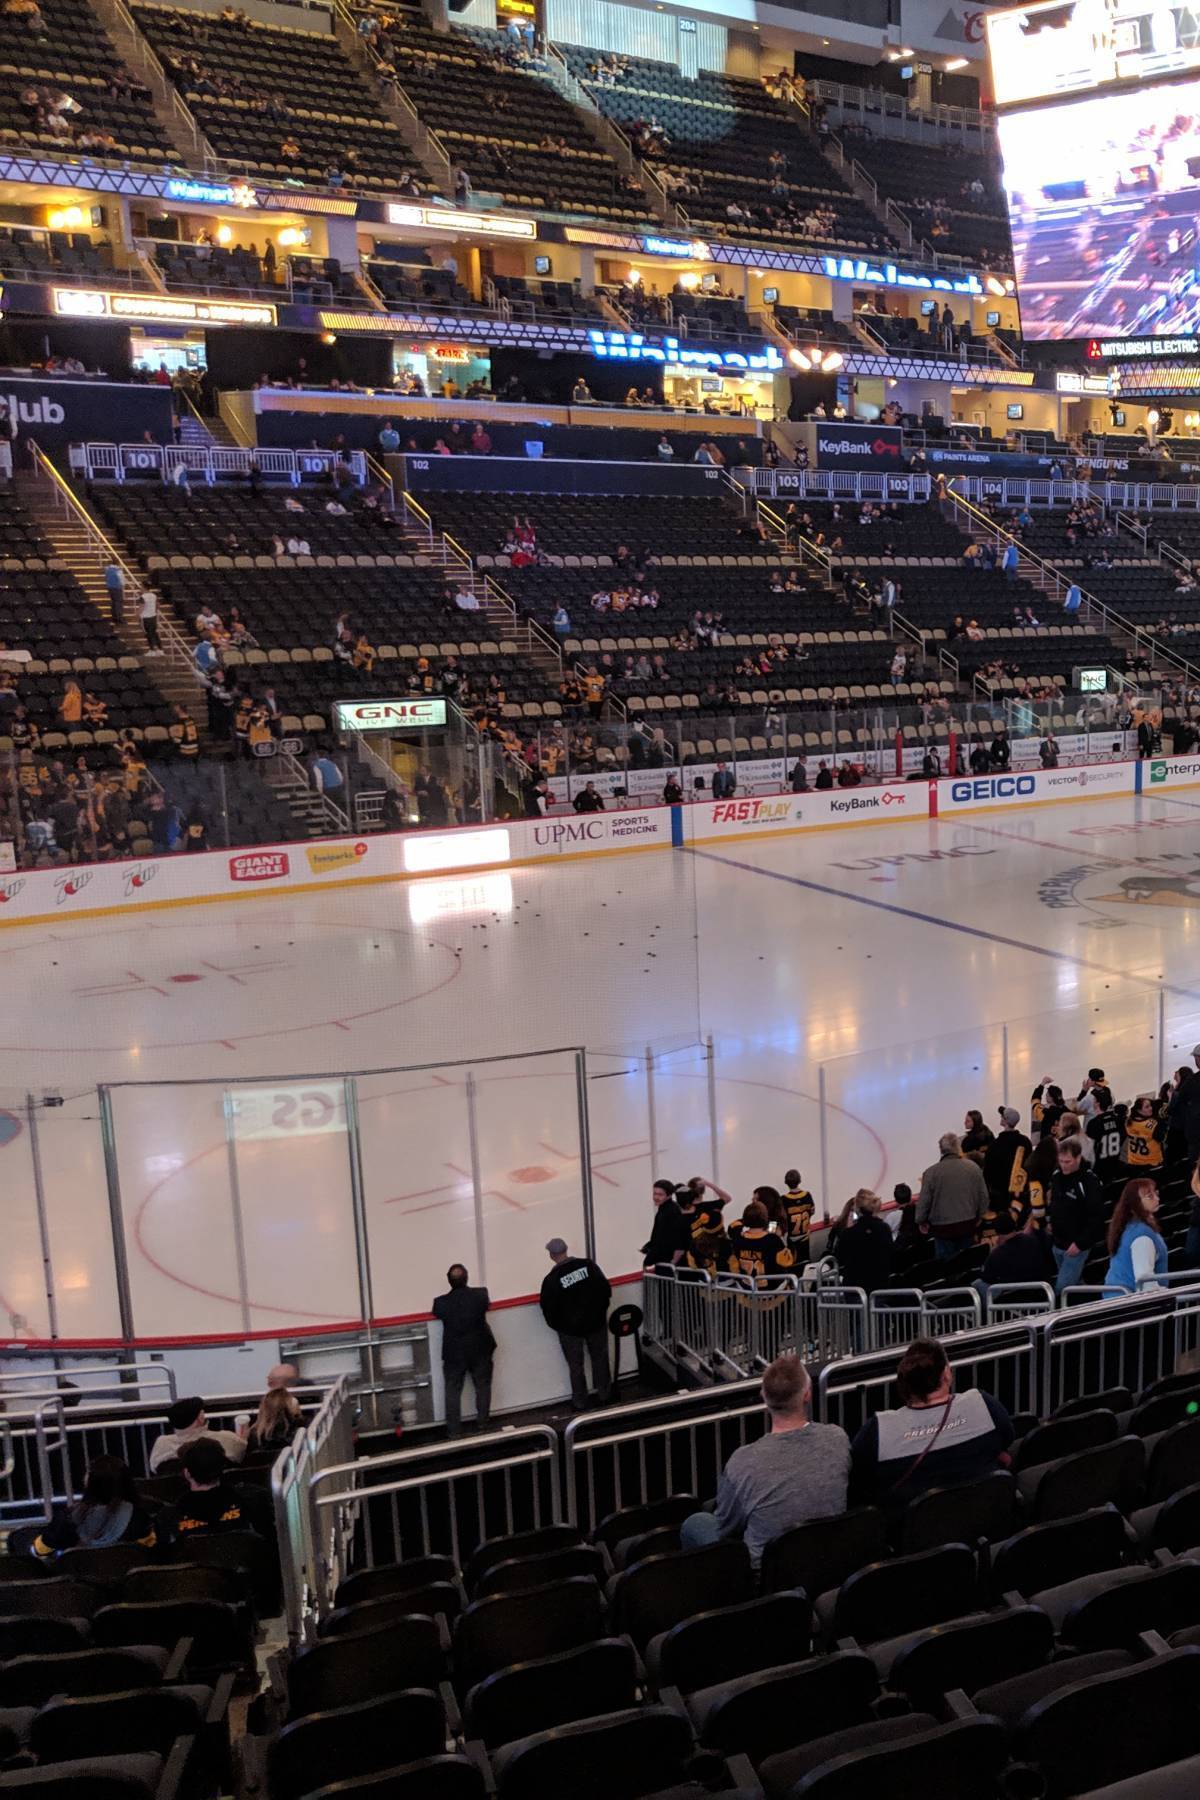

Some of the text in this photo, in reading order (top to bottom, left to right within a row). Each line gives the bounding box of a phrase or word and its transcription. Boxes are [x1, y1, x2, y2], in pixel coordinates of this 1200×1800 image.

[679, 19, 697, 32] 204
[169, 180, 235, 201] Walmart
[1101, 339, 1199, 356] MITSUBISHI ELECTRIC
[818, 439, 872, 456] KeyBank
[127, 454, 157, 469] 101
[303, 458, 330, 473] 101
[412, 459, 430, 470] 102
[943, 453, 966, 462] PAINTS
[967, 454, 990, 463] ARENA
[1075, 457, 1129, 470] PENGUNS
[703, 469, 719, 480] 102
[777, 475, 799, 488] 103
[889, 479, 909, 492] 103
[984, 483, 1002, 495] 104
[355, 703, 433, 720] GNC
[1047, 771, 1124, 786] VECTOR SECURITY
[951, 775, 1036, 802] GEICO
[830, 795, 880, 812] KeyBank
[611, 815, 650, 828] SPORTS
[533, 820, 604, 846] UPMC
[611, 824, 658, 836] MEDICINE
[233, 853, 285, 869] GIANT
[827, 844, 998, 873] UPMC
[234, 864, 285, 879] EAGLE
[1100, 1132, 1121, 1159] 18
[560, 1266, 589, 1289] SECURITY
